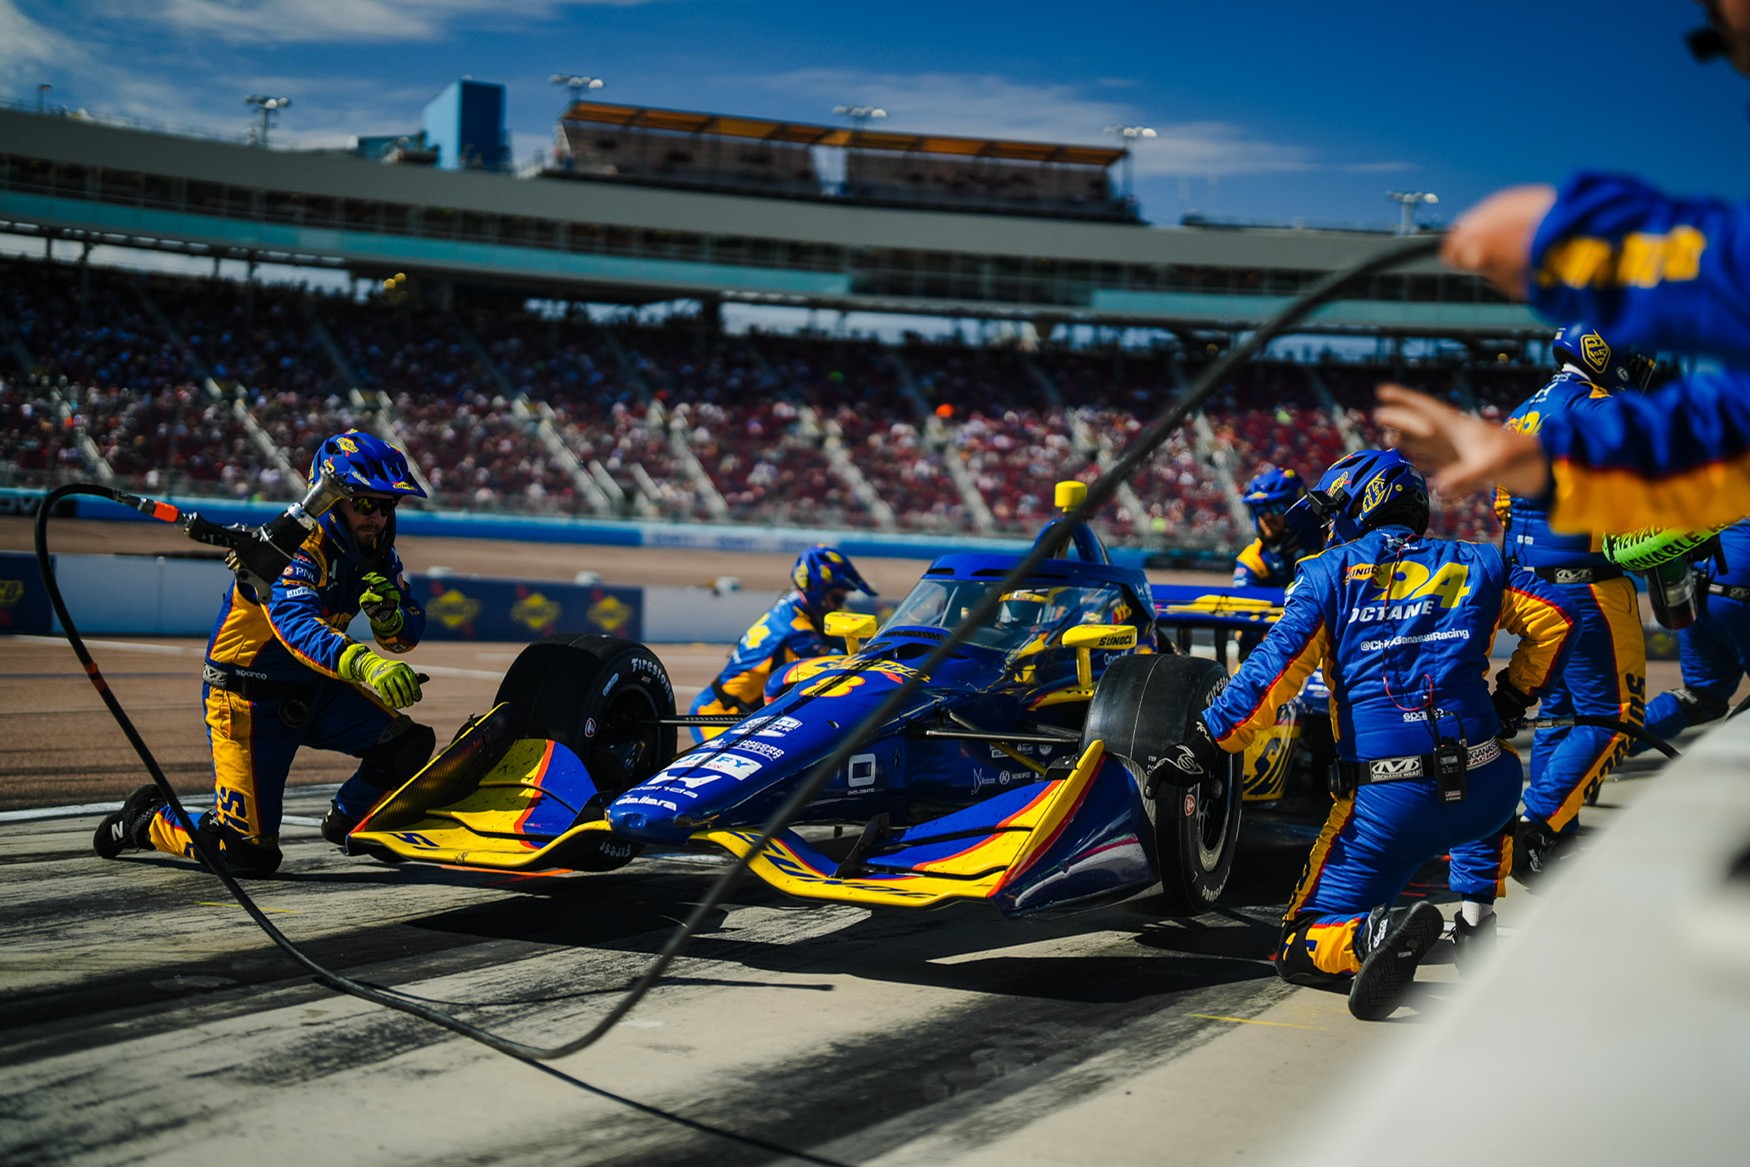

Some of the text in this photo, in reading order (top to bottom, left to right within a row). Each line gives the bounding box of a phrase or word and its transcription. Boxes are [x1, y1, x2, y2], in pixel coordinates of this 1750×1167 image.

[1371, 560, 1471, 609] 94
[235, 668, 268, 680] sparco
[630, 657, 675, 703] Firestone
[1205, 676, 1229, 707] Firest
[1402, 707, 1445, 723] spao
[675, 754, 751, 769] JIFY
[600, 840, 632, 859] Firest
